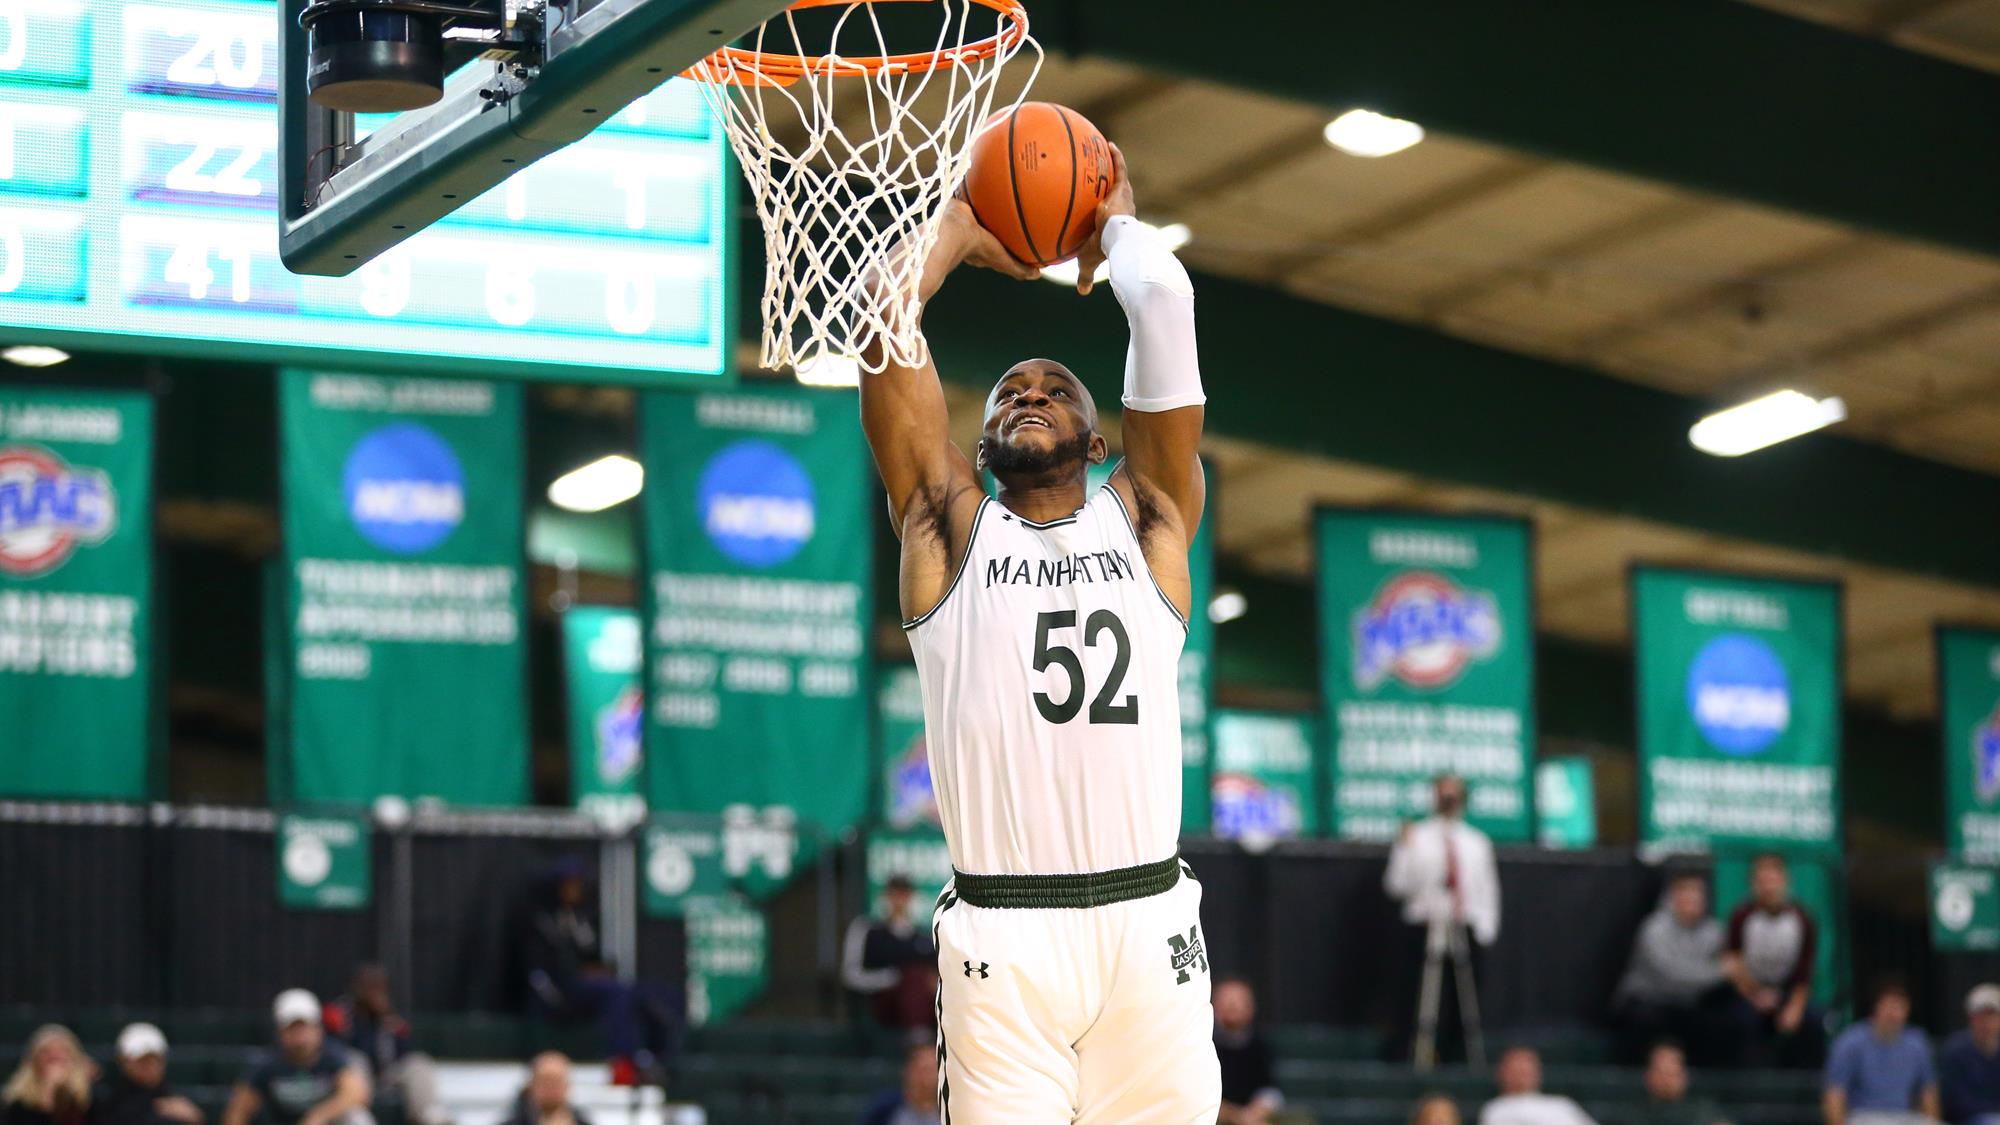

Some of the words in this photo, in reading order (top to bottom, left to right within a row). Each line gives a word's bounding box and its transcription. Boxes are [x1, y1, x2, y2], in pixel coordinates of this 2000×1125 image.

[167, 20, 263, 88] 20
[166, 128, 262, 196] 22
[165, 237, 251, 302] 41
[986, 549, 1135, 588] MANHATTAN
[1033, 609, 1138, 725] 52
